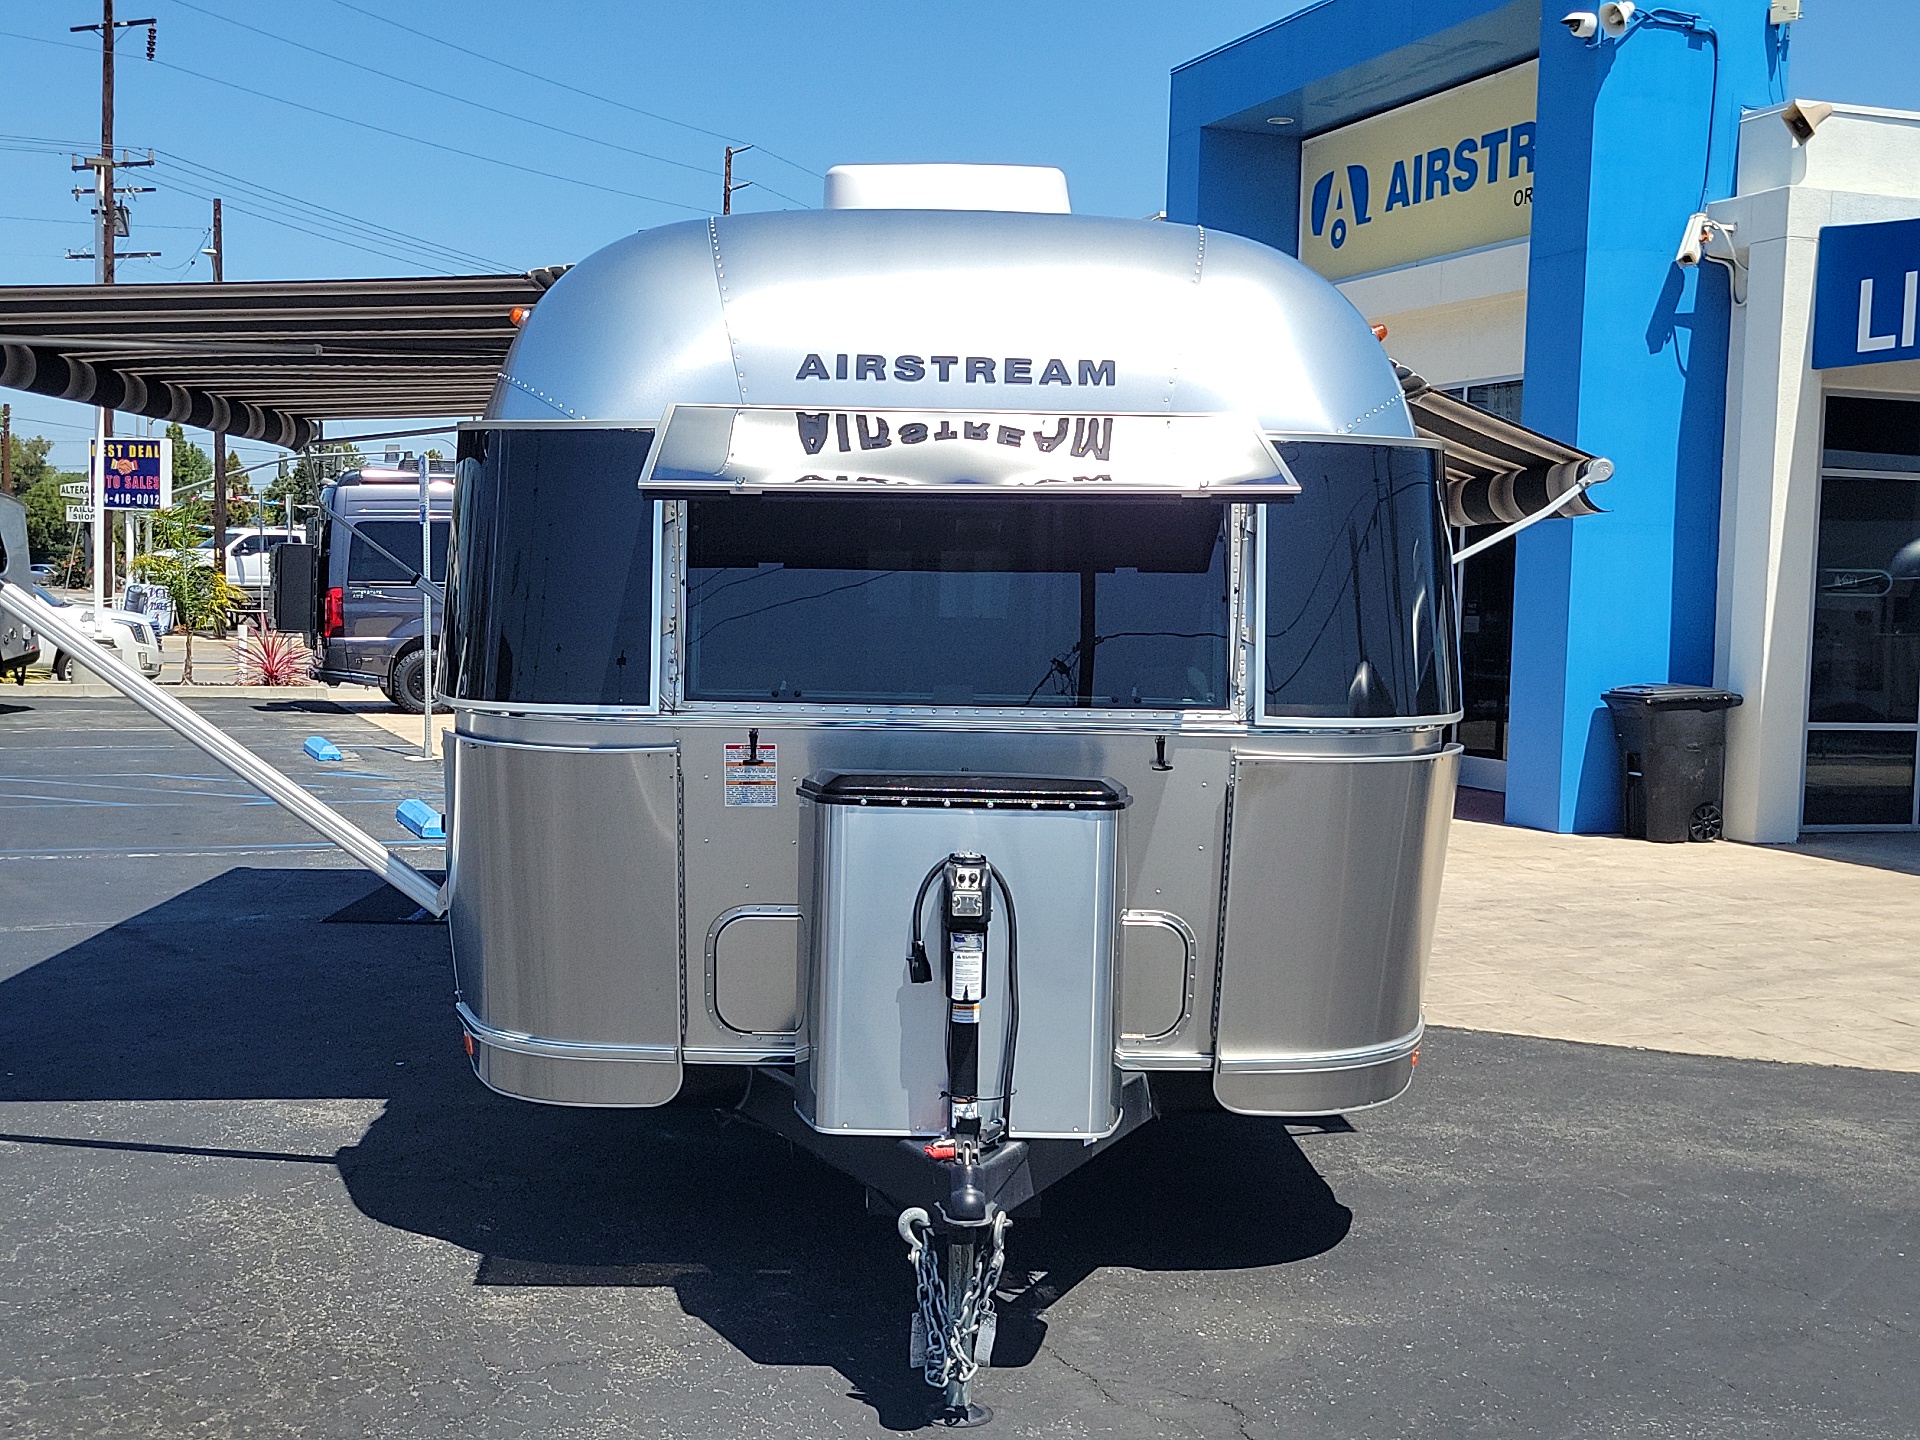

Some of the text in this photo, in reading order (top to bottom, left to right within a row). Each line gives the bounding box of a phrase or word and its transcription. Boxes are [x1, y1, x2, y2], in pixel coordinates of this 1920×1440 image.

[1857, 270, 1918, 353] LI
[795, 354, 1116, 386] AIRSTREAM
[129, 444, 160, 458] DEAL
[124, 475, 160, 490] SALES
